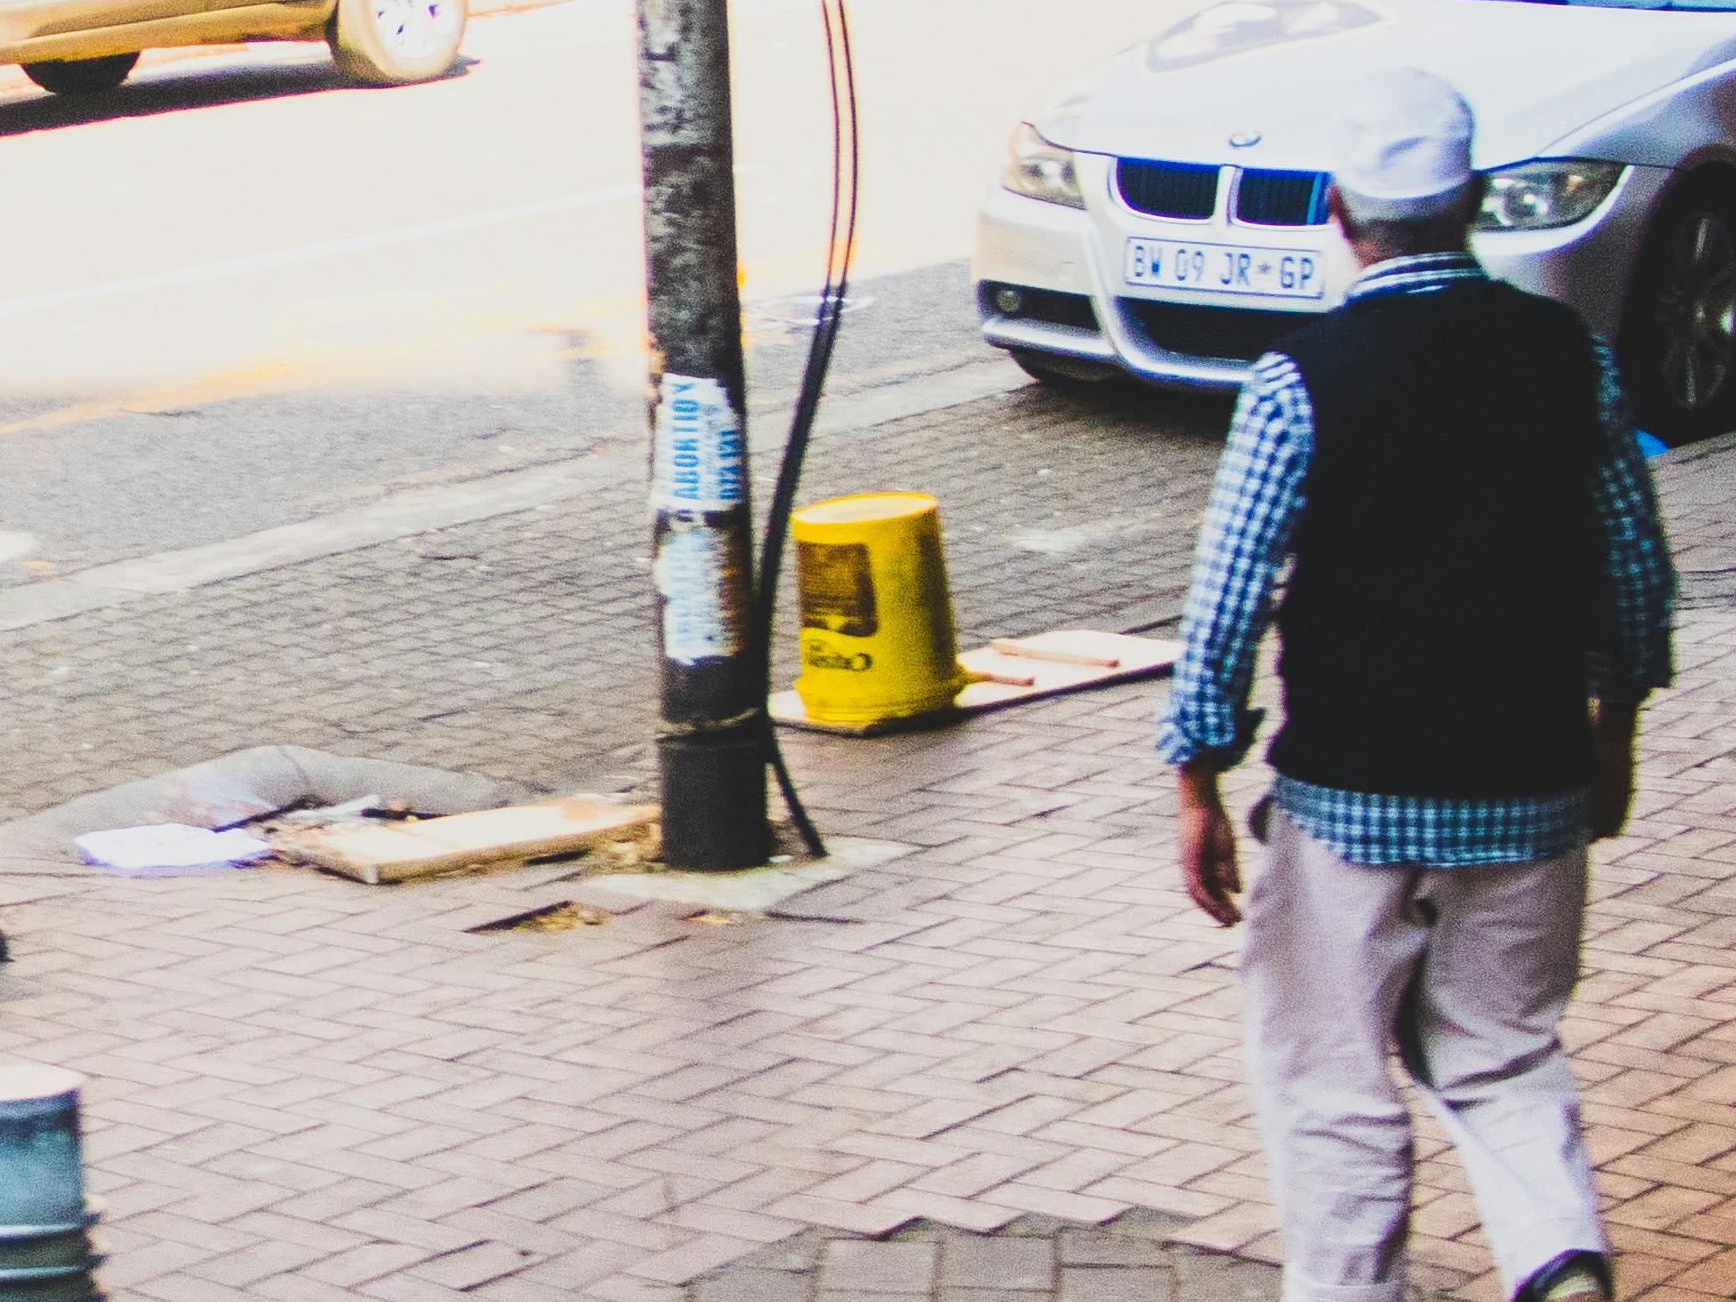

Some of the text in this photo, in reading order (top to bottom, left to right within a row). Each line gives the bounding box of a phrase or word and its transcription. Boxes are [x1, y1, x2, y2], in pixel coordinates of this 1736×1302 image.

[1134, 245, 1315, 290] BW 09 JR GP
